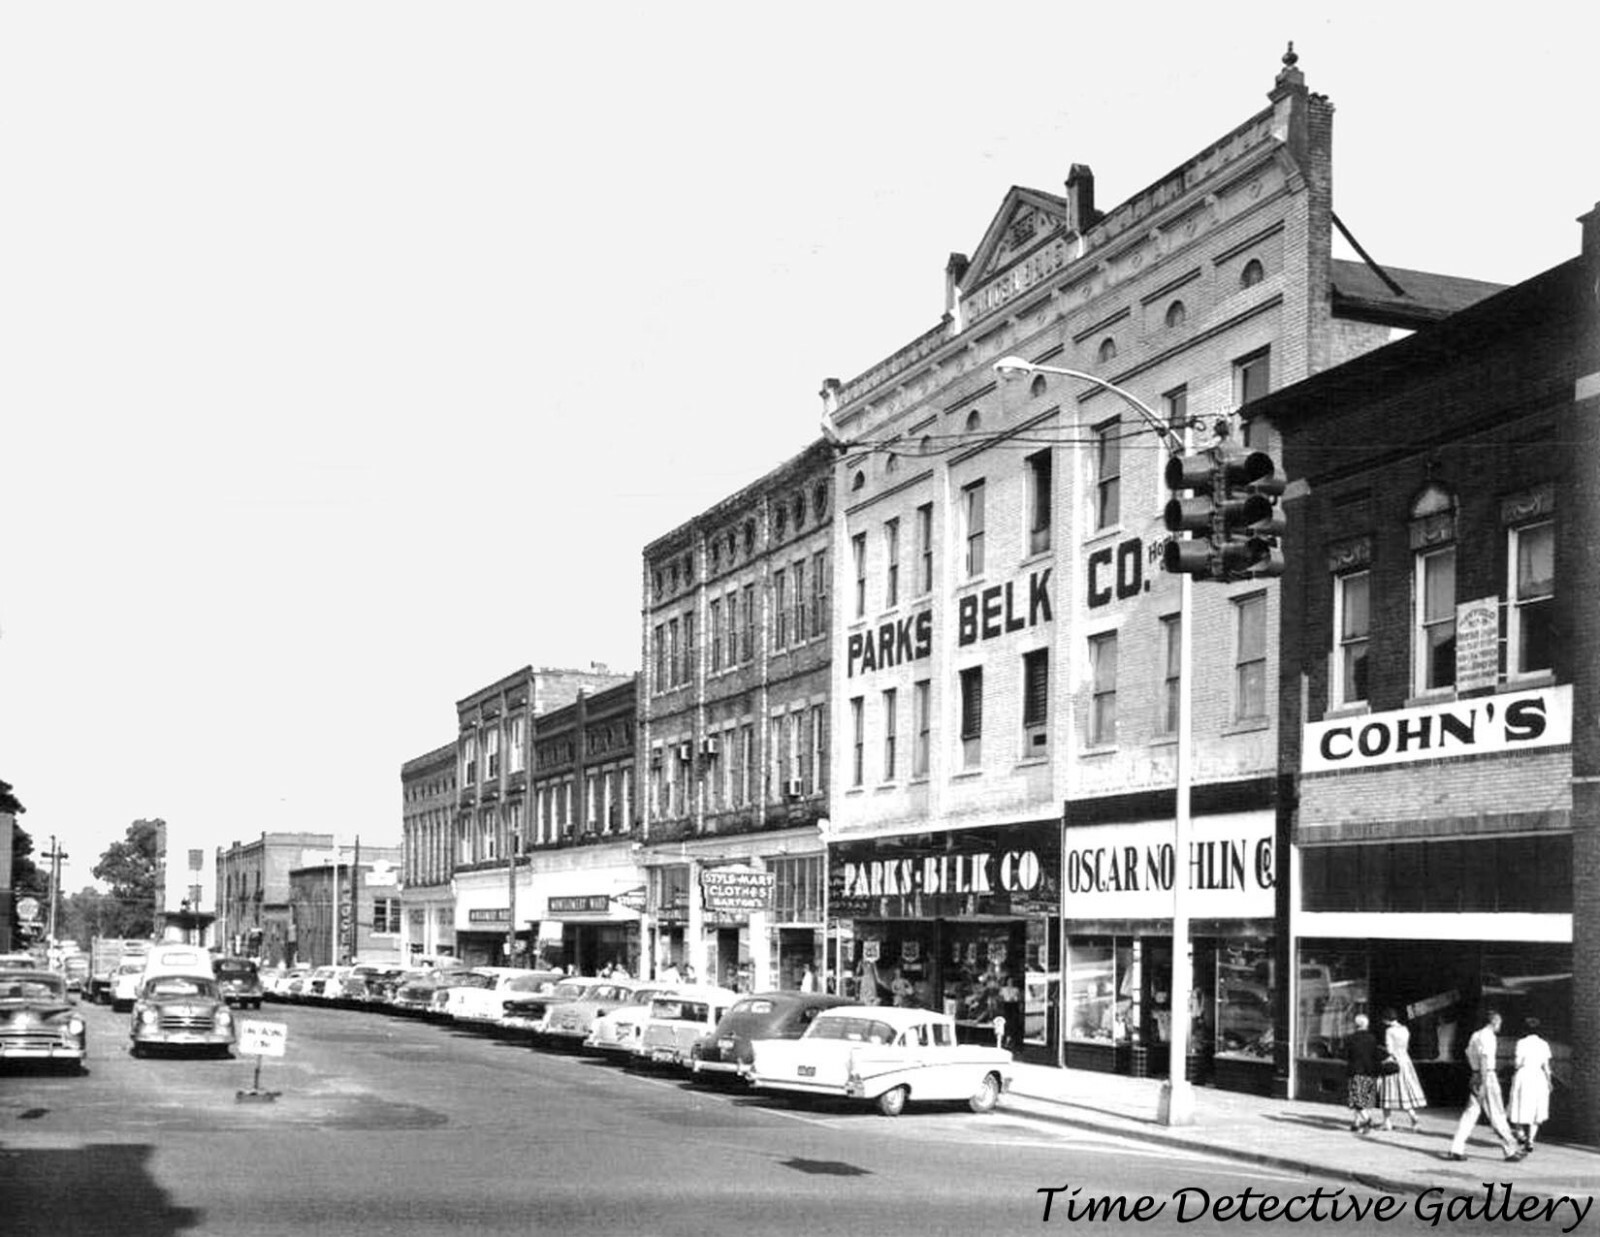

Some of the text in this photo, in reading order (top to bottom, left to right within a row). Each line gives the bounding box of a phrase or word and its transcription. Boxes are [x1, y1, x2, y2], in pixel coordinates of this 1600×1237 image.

[848, 537, 1150, 678] PARKS BELK CO.
[1320, 697, 1546, 760] COHN'S
[709, 885, 767, 898] CLOTHES
[1001, 850, 1040, 891] CO
[1068, 846, 1140, 893] OSCAR
[1145, 839, 1246, 892] NOHLIN
